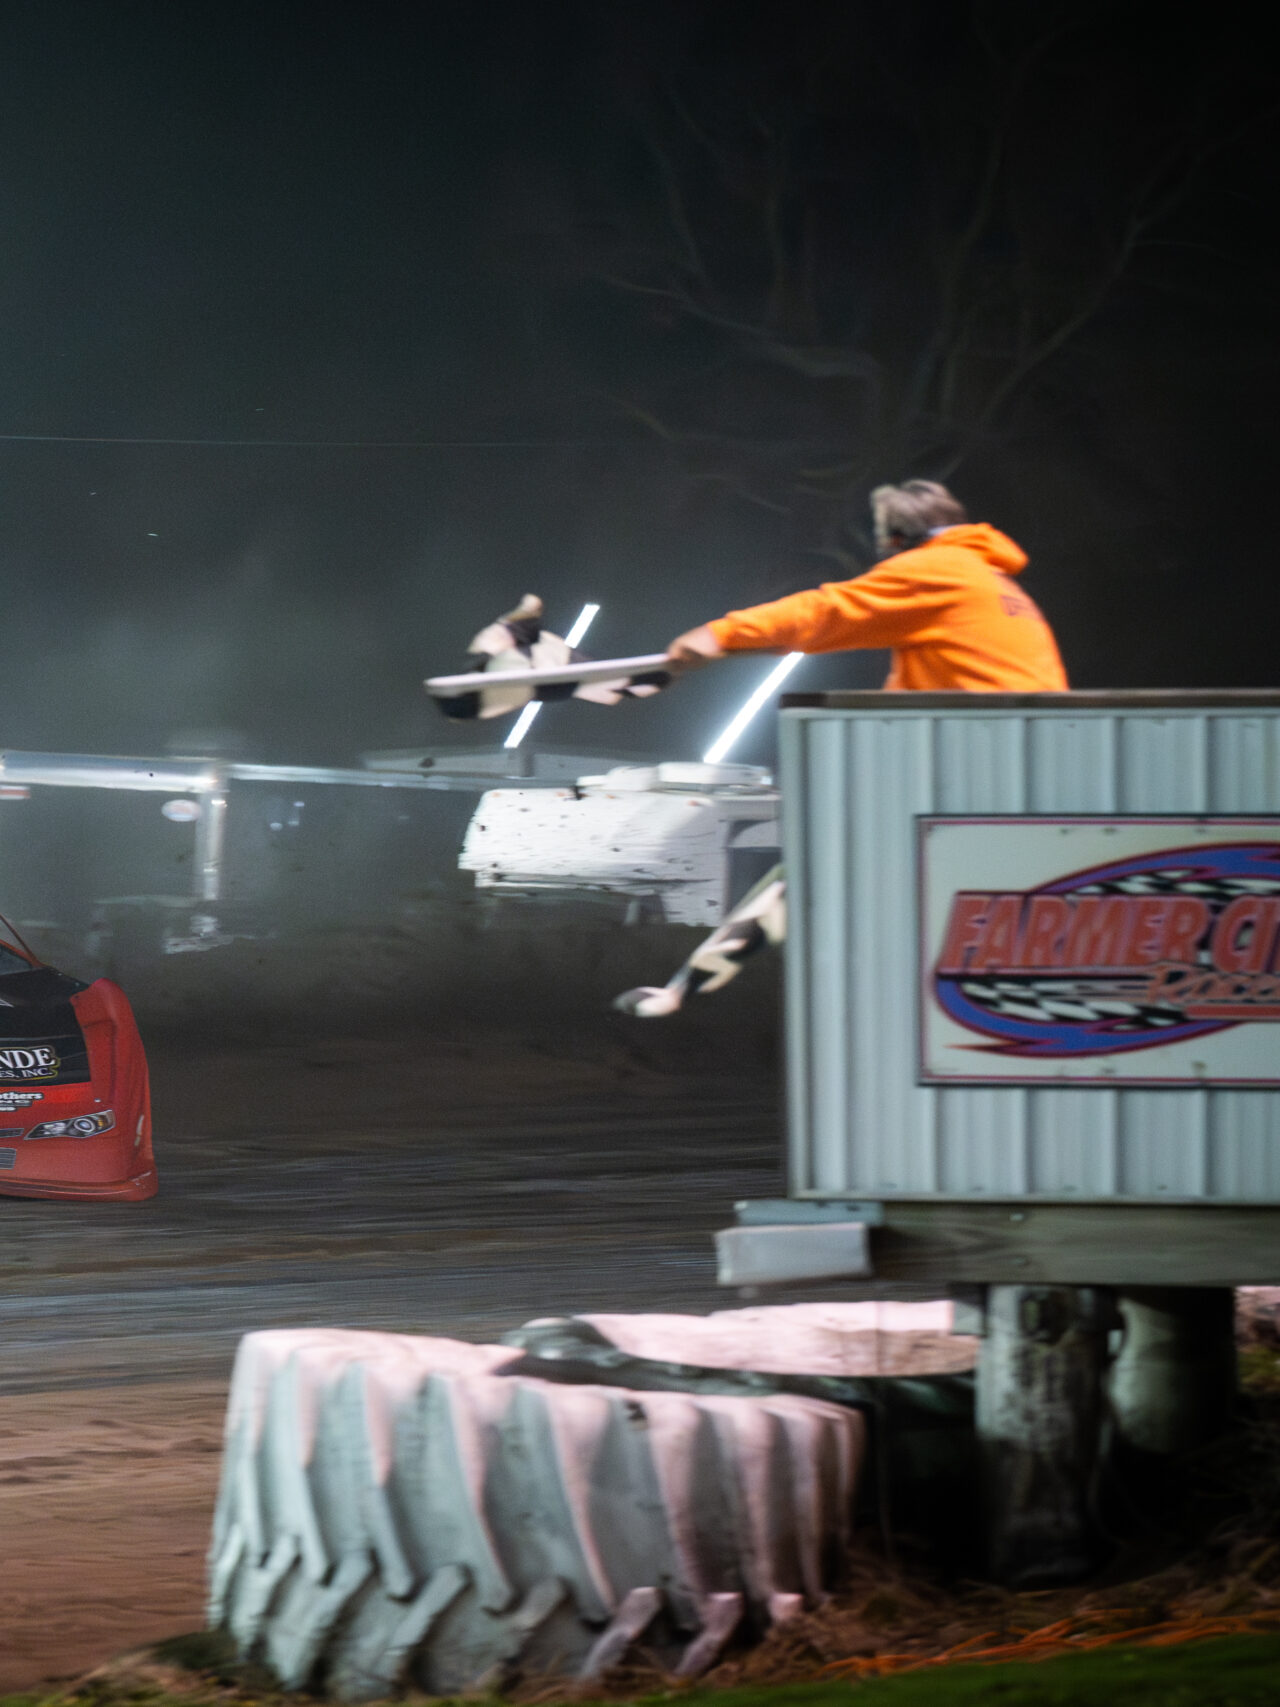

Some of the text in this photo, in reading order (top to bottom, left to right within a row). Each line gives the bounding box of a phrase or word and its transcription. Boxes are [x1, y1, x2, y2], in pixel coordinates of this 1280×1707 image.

[936, 893, 1280, 975] FARMER CI
[22, 1067, 53, 1078] INC.
